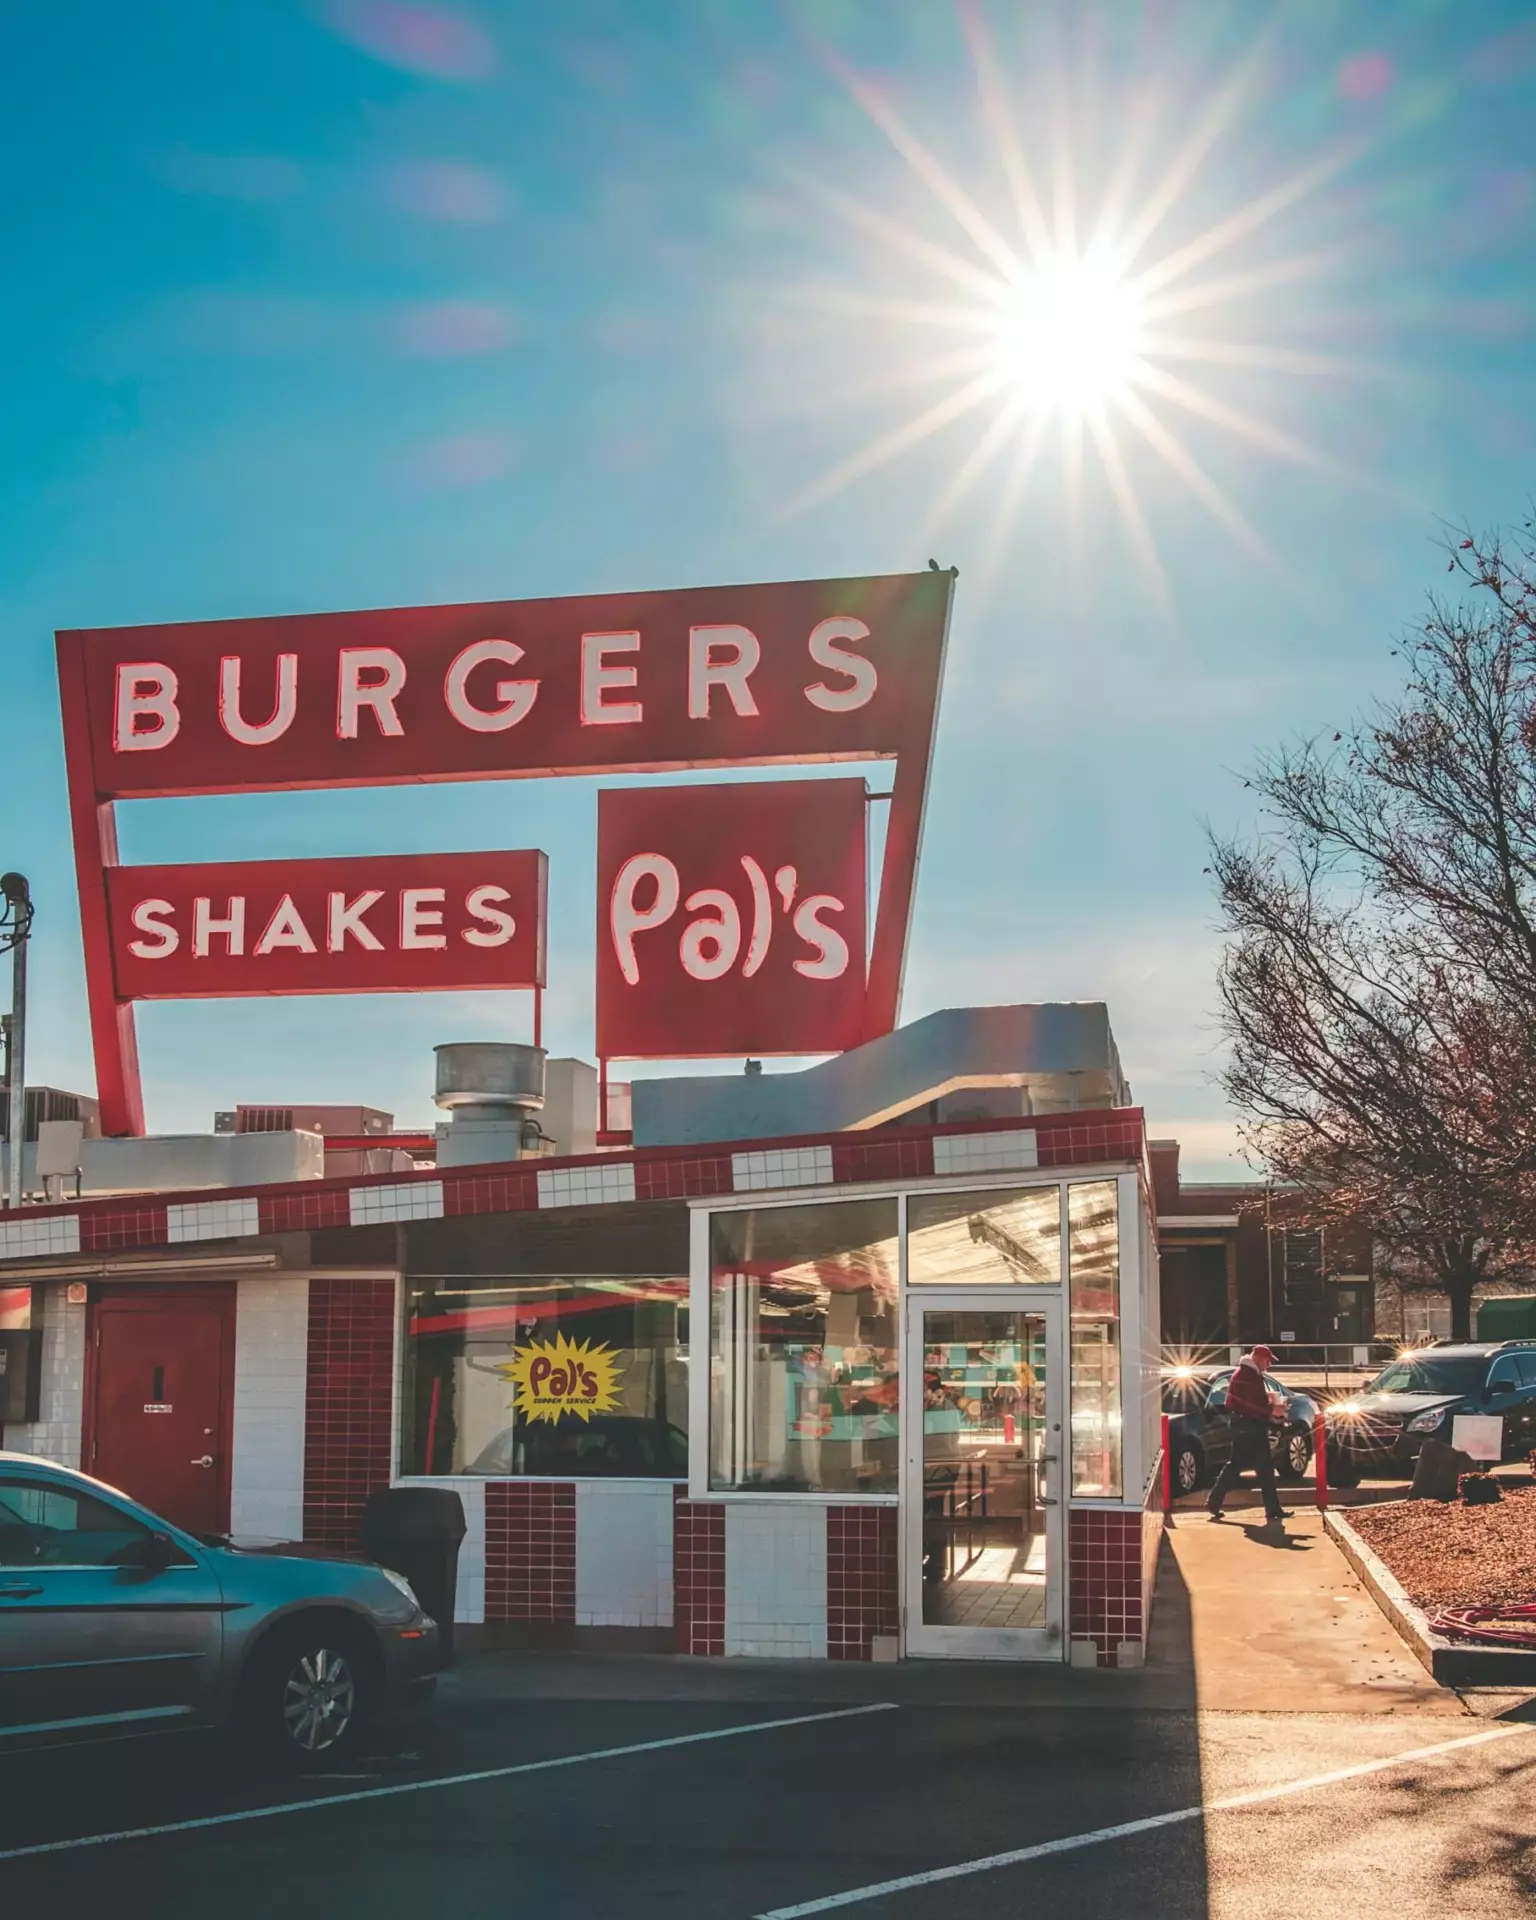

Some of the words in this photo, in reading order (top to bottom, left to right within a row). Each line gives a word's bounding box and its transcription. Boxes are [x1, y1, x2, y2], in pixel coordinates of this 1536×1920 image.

[113, 616, 878, 752] BURGERS
[128, 886, 516, 959] SHAKES
[611, 853, 849, 985] Pal's
[530, 1356, 598, 1397] Pal's
